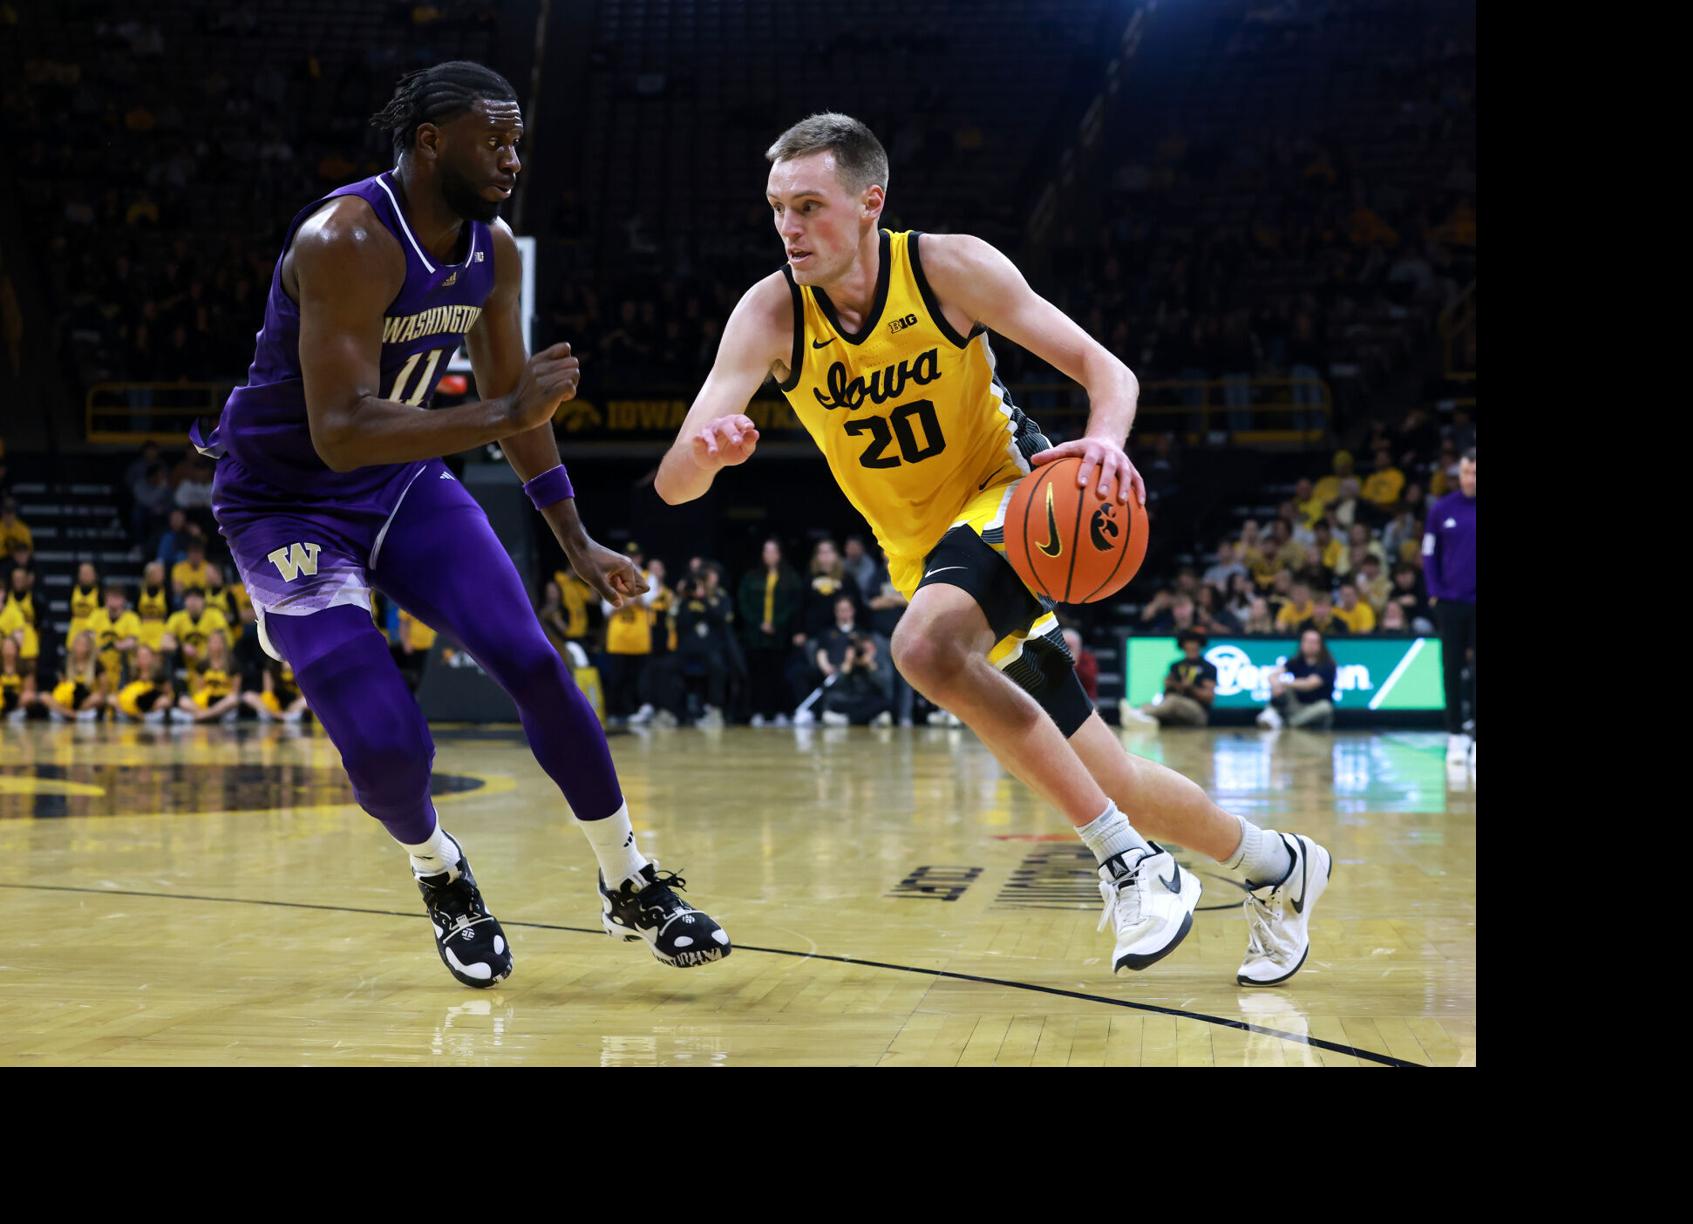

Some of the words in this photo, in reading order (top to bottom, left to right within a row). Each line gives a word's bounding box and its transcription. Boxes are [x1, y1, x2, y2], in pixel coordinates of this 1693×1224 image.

[389, 349, 443, 407] 11
[813, 347, 942, 410] Iowa
[844, 399, 947, 468] 20
[267, 542, 322, 583] W
